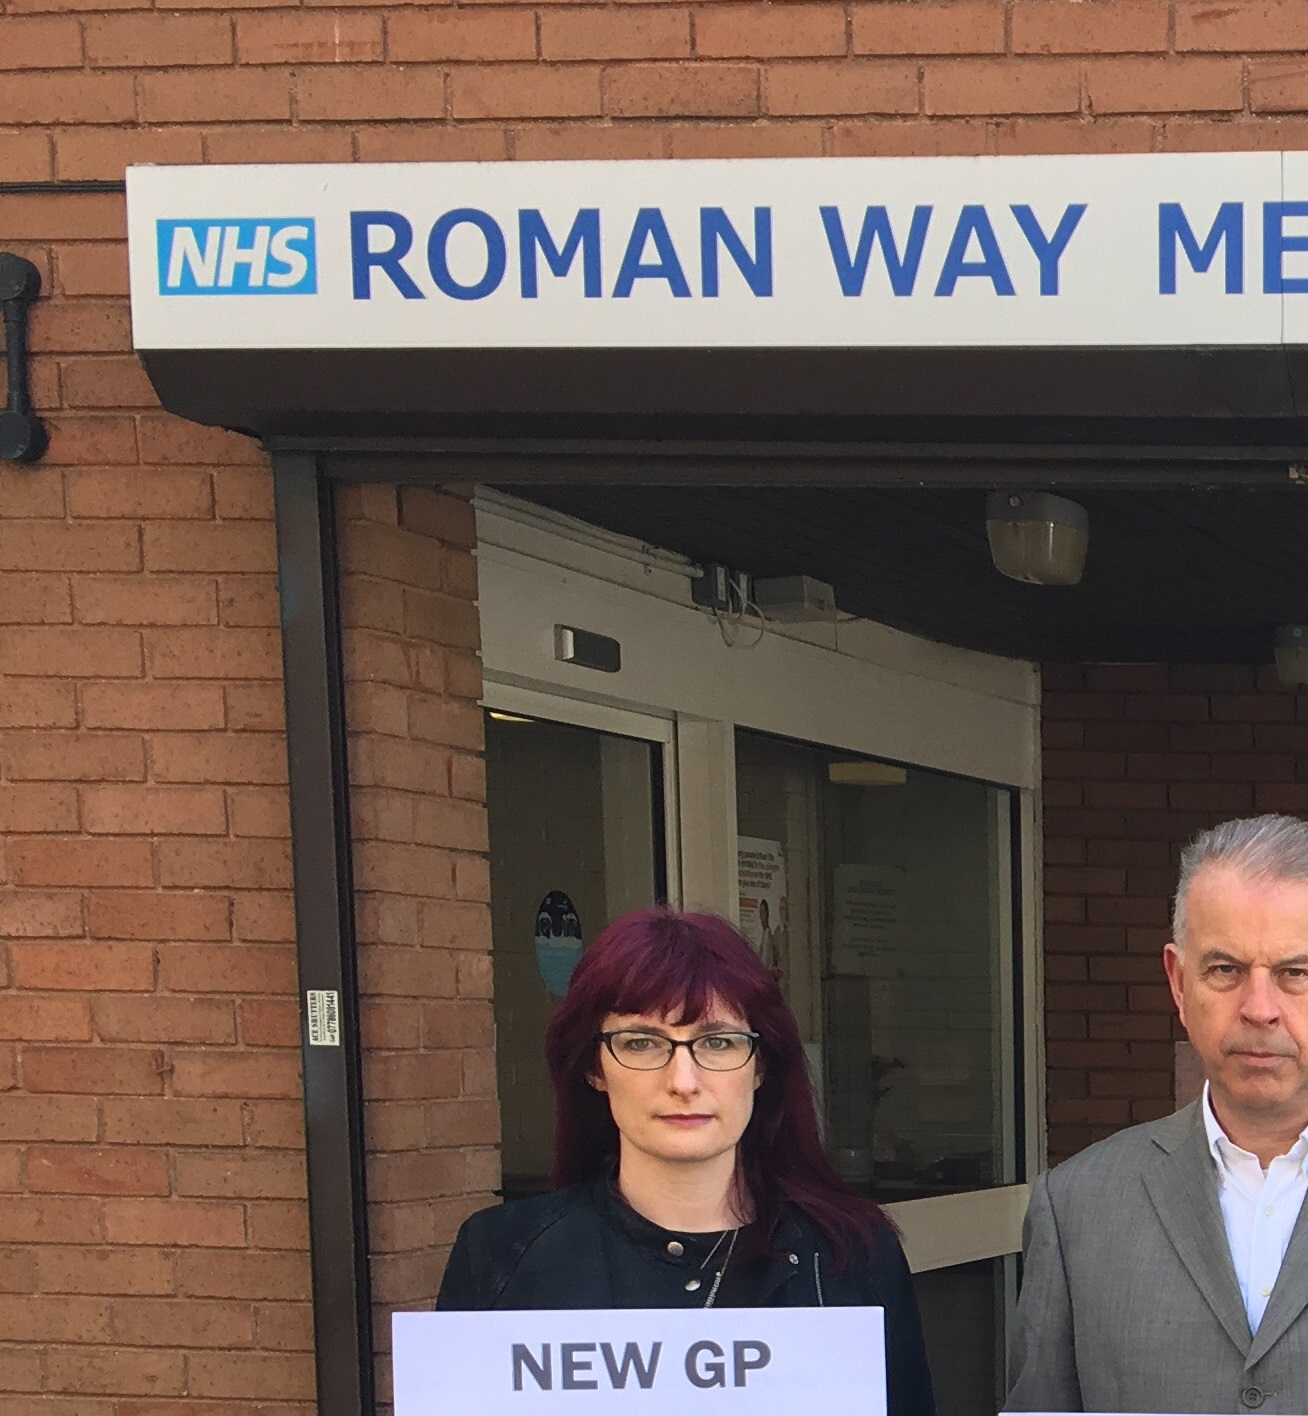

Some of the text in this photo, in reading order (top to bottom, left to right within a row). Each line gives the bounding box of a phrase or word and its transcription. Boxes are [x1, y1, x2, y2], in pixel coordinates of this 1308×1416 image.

[167, 225, 309, 288] NHS
[349, 206, 774, 301] ROMAN
[818, 203, 1088, 298] WAY
[511, 1339, 772, 1392] NEW GP
